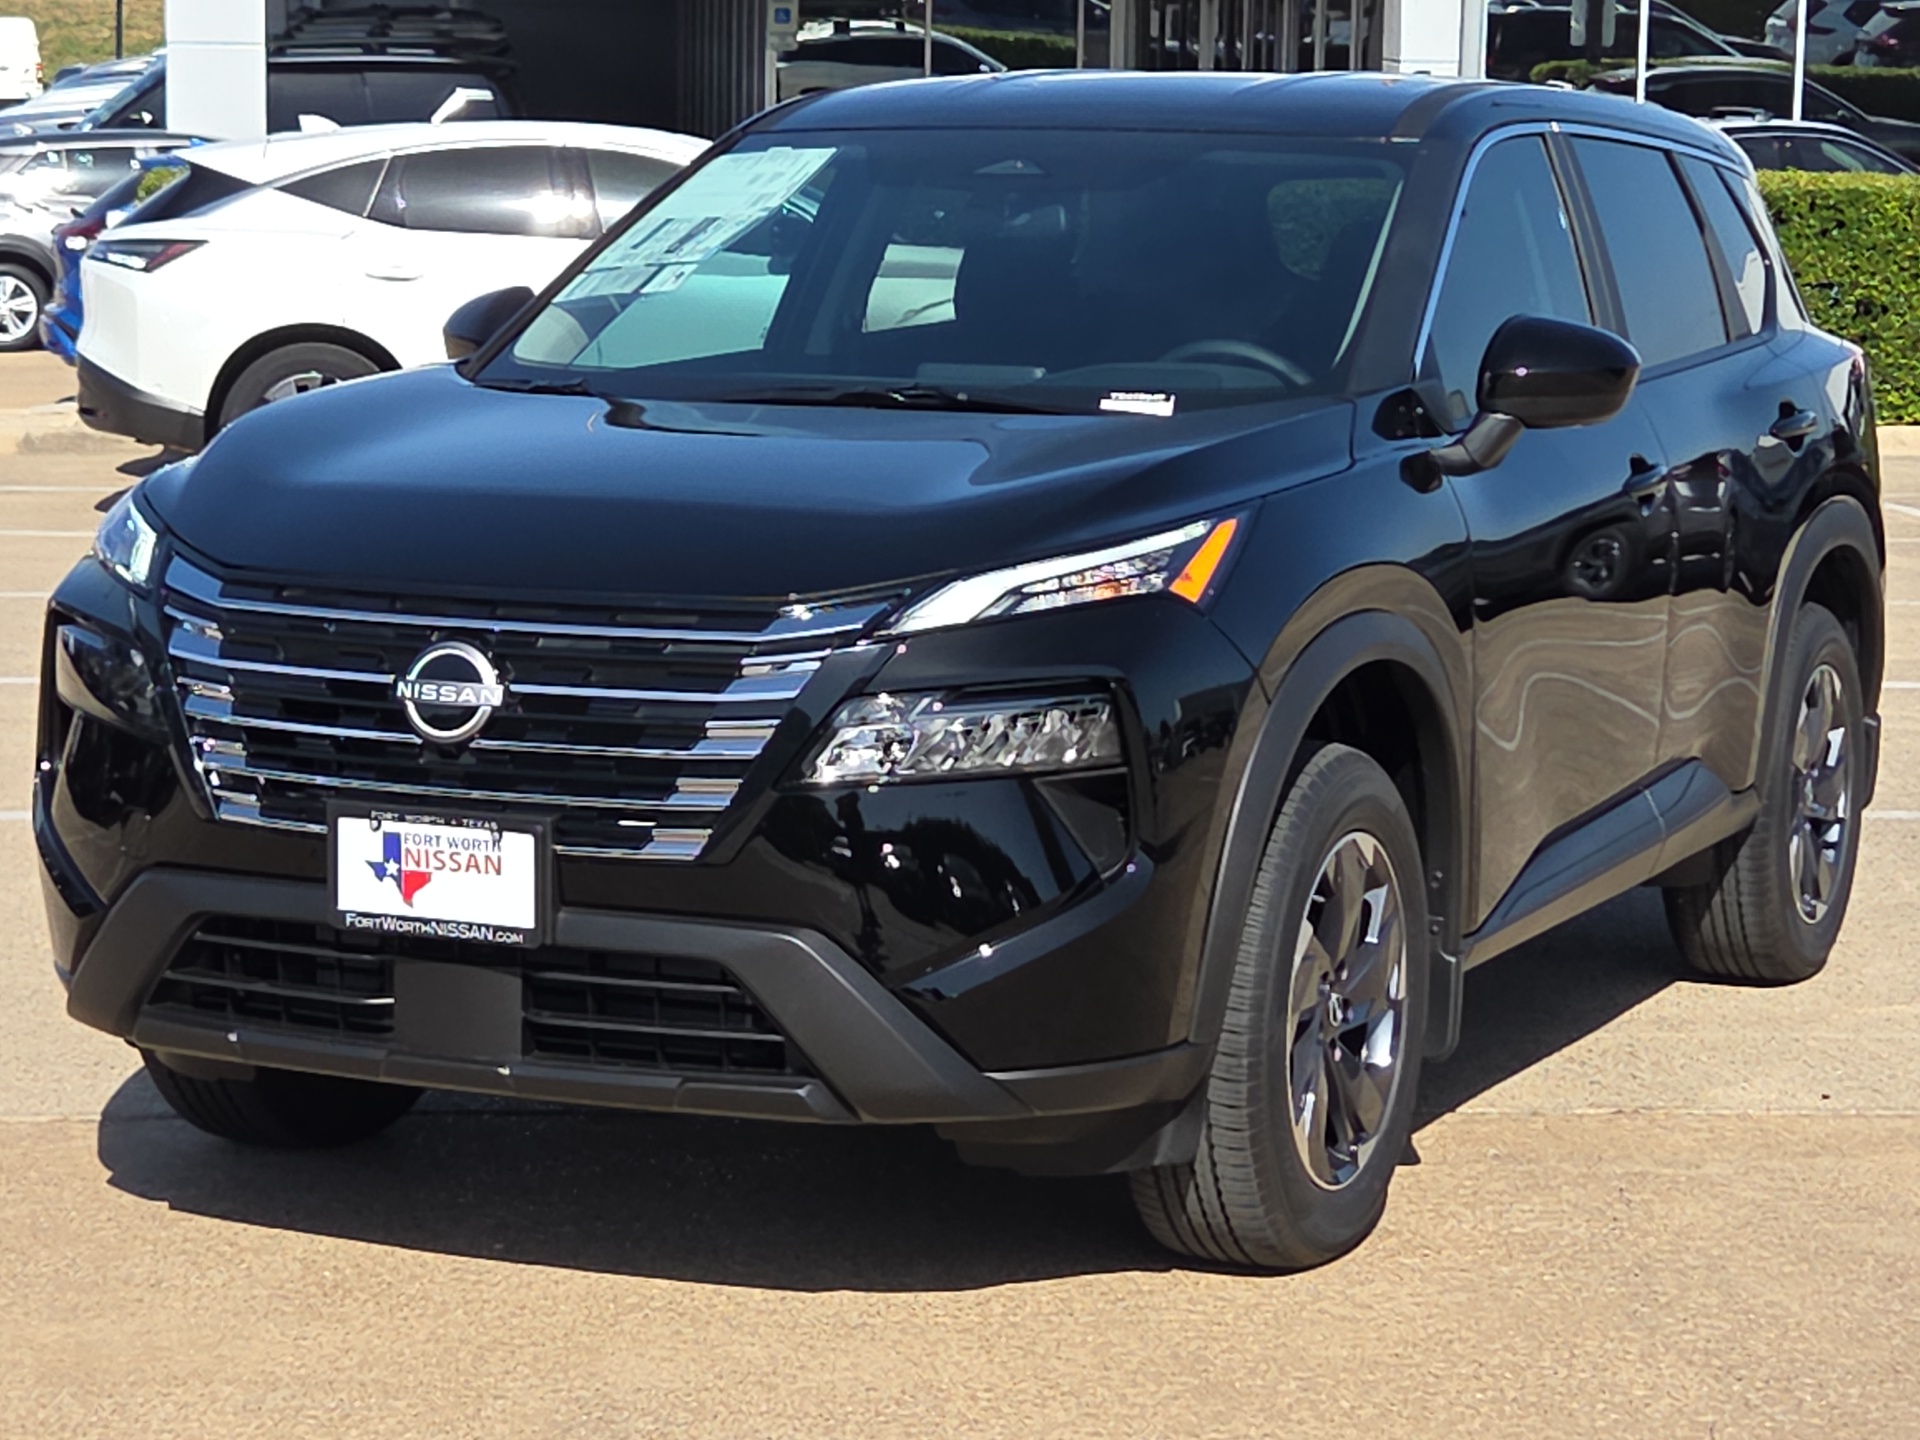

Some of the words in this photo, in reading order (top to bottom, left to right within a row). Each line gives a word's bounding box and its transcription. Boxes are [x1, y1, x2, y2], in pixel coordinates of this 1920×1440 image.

[396, 680, 503, 707] NISSAN
[370, 810, 400, 822] FORT
[462, 818, 498, 830] TEXAS
[404, 832, 441, 848] FORT
[447, 836, 501, 852] WORTH
[404, 847, 501, 876] NISSAN
